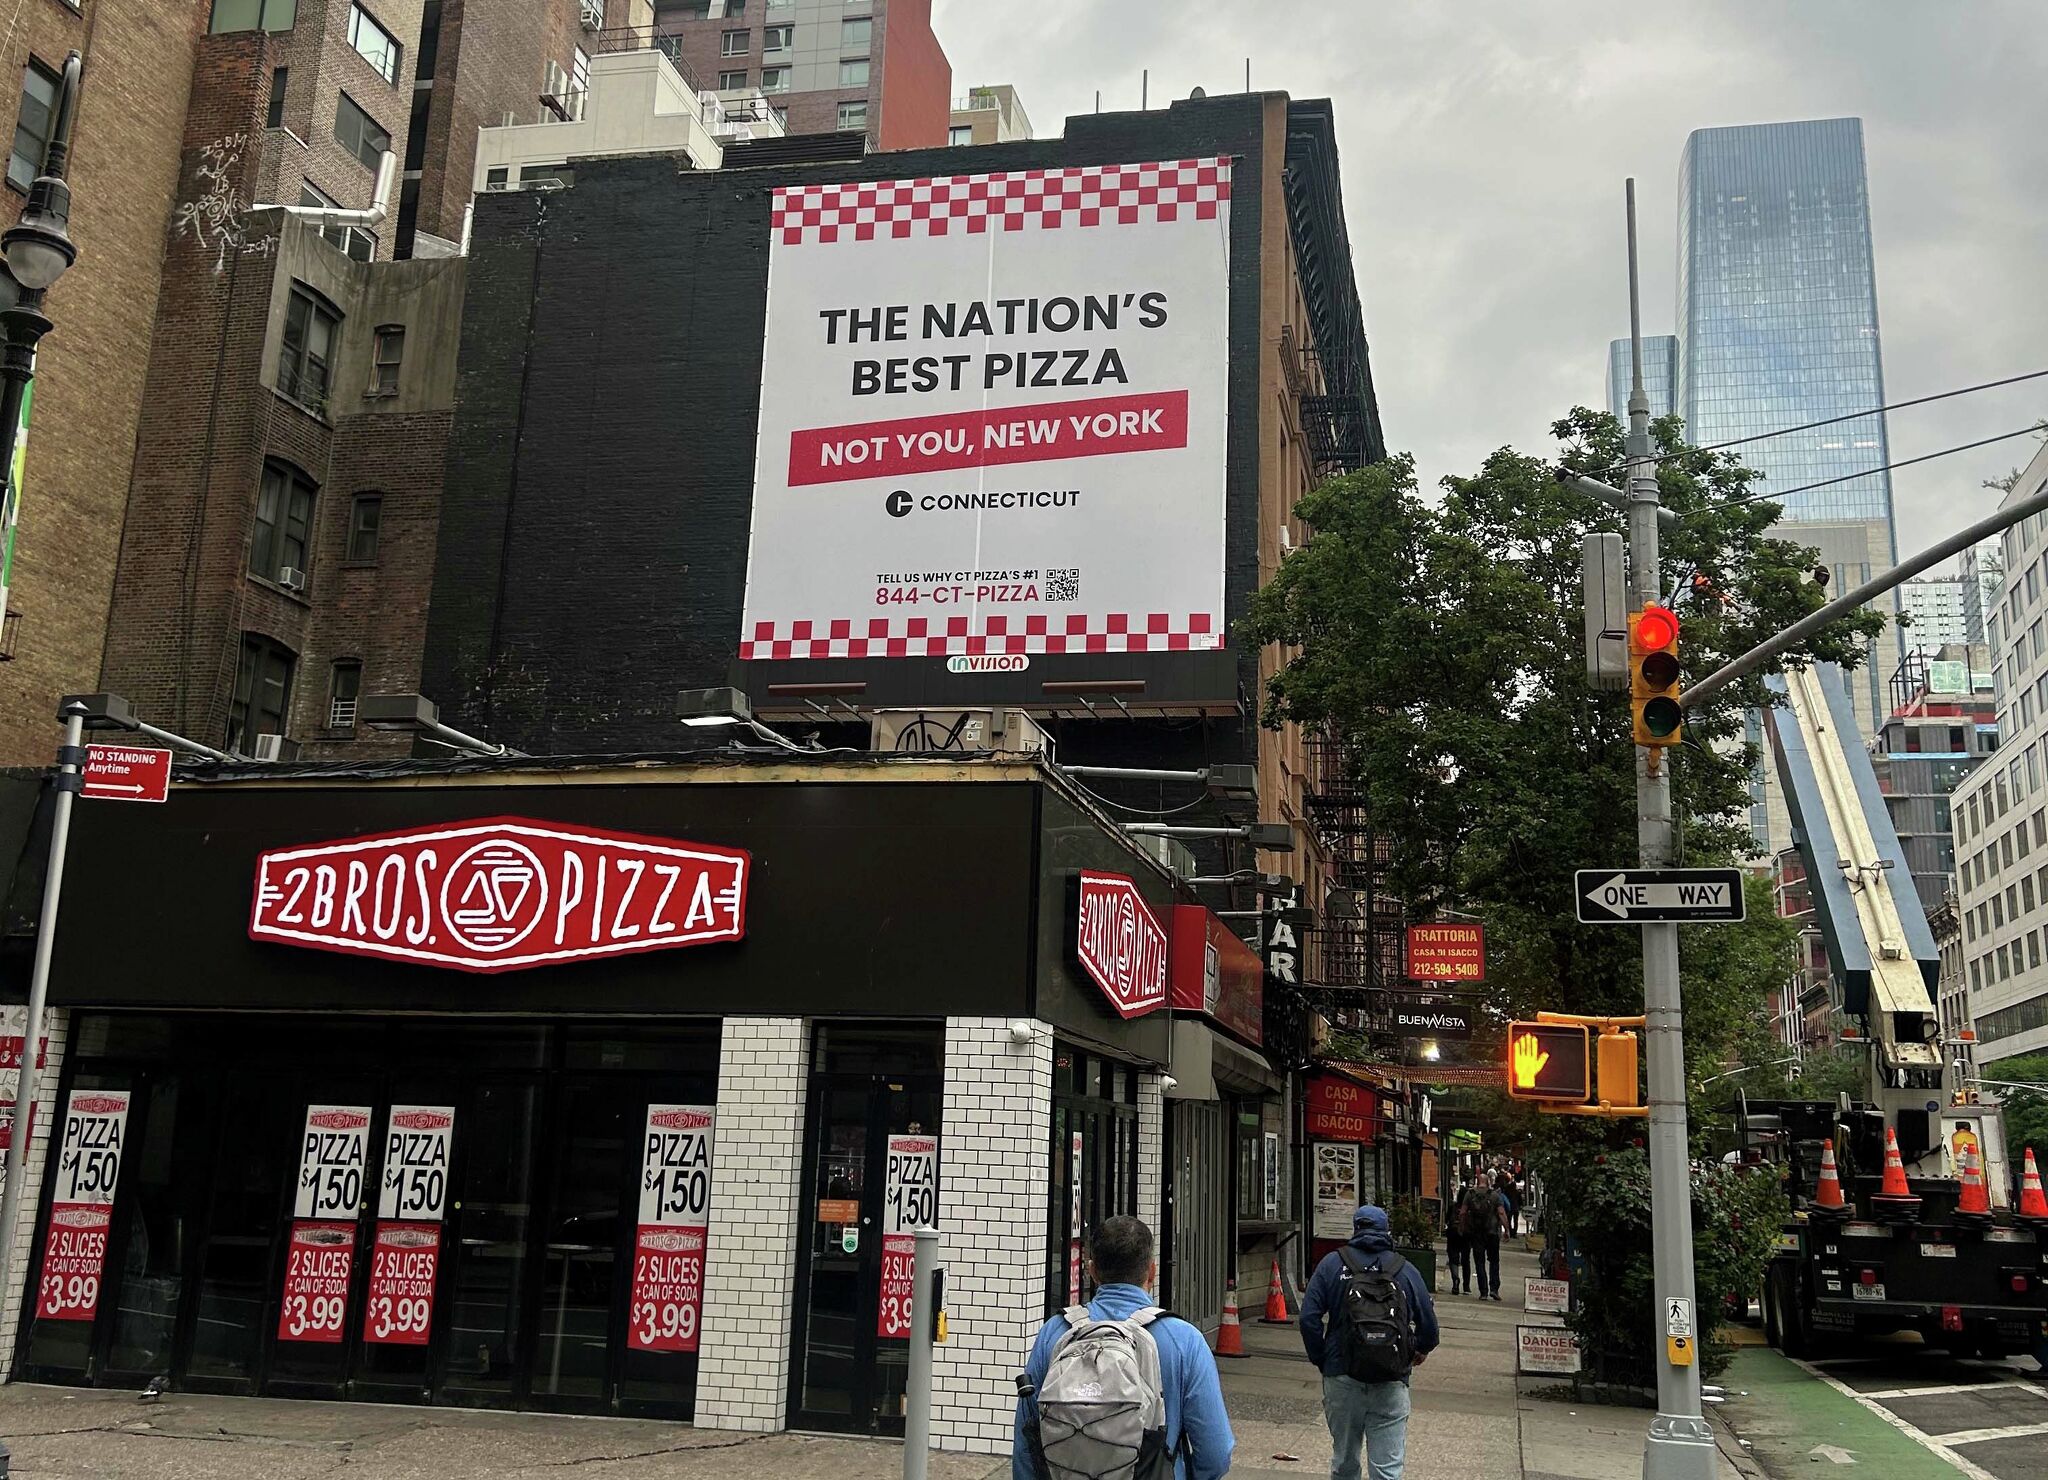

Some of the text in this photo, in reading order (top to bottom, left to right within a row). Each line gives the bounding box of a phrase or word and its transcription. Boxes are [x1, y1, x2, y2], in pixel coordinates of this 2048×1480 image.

[820, 292, 1168, 345] THE NATION'S
[852, 348, 1129, 396] BEST PIZZA
[820, 408, 1164, 467] NOT YOU, NEW YORK
[920, 490, 1080, 512] CONNECTICUT
[877, 570, 1038, 584] TELL US WHY CT PIZZA'S #1
[876, 584, 1039, 605] 844-CT-PIZZA
[88, 762, 130, 775] Anytime
[90, 750, 156, 764] NO STANDING
[554, 850, 716, 945] PIZZA
[1604, 886, 1724, 906] ONE WAY
[1414, 930, 1478, 942] TRATTORIA
[1135, 911, 1162, 997] PIZZA
[1325, 1086, 1358, 1101] CASA
[65, 1116, 120, 1150] PIZZA
[688, 1116, 708, 1126] PIZZA
[1317, 1114, 1362, 1132] ISACCO
[304, 1133, 362, 1166] PIZZA
[387, 1133, 446, 1166] PIZZA
[646, 1133, 708, 1168] PIZZA
[62, 1150, 118, 1199] $1.50
[888, 1156, 933, 1186] PIZZA
[302, 1167, 360, 1217] $1.50
[386, 1168, 444, 1218] $1.50
[645, 1168, 706, 1220] $1.50
[888, 1186, 932, 1231] $1.50
[49, 1232, 105, 1258] 2 SLICES
[52, 1258, 68, 1272] CAN
[70, 1259, 80, 1274] OF
[80, 1260, 101, 1274] SODA
[290, 1250, 350, 1278] 2 SLICES
[375, 1252, 434, 1280] 2 SLICES
[638, 1256, 700, 1284] 2 SLICES
[884, 1256, 914, 1280] 2 SLIC
[42, 1274, 98, 1314] $3.99
[294, 1278, 311, 1293] CAN
[313, 1278, 324, 1294] OF
[325, 1280, 347, 1294] SODA
[380, 1280, 396, 1294] CAN
[398, 1280, 409, 1296] OF
[410, 1281, 432, 1296] SODA
[642, 1284, 660, 1300] CAN
[662, 1284, 674, 1300] OF
[675, 1286, 698, 1302] SODA
[888, 1282, 900, 1294] CAN
[902, 1282, 910, 1295] OF
[1528, 1284, 1566, 1294] DANGER
[284, 1294, 344, 1336] $3.99
[370, 1297, 429, 1338] $3.99
[633, 1302, 696, 1344] $3.99
[882, 1297, 912, 1334] $3.9
[1522, 1336, 1579, 1348] DANGER
